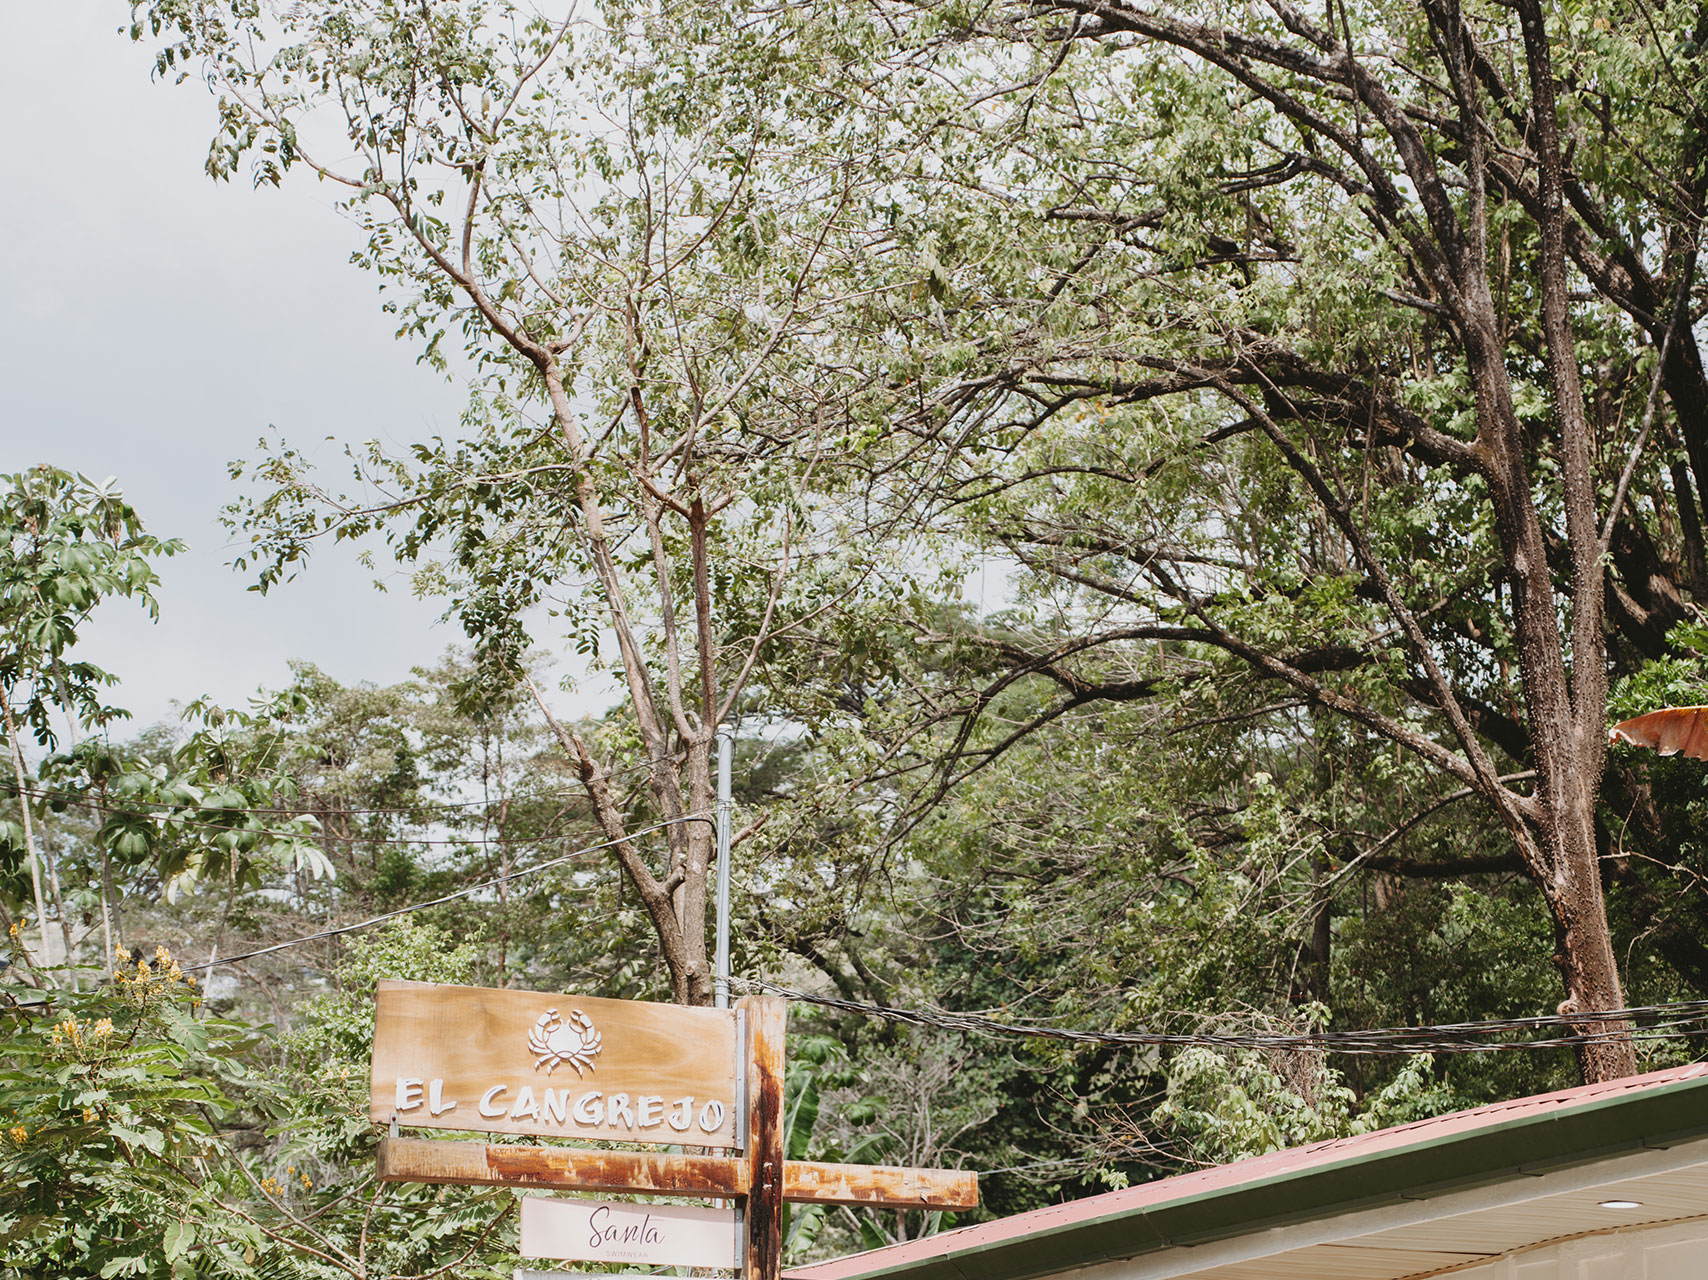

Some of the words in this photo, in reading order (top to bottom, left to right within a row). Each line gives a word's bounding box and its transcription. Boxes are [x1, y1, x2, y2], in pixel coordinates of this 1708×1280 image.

[395, 1077, 457, 1115] EL
[478, 1084, 725, 1132] CANGREJO
[589, 1205, 665, 1248] Santa
